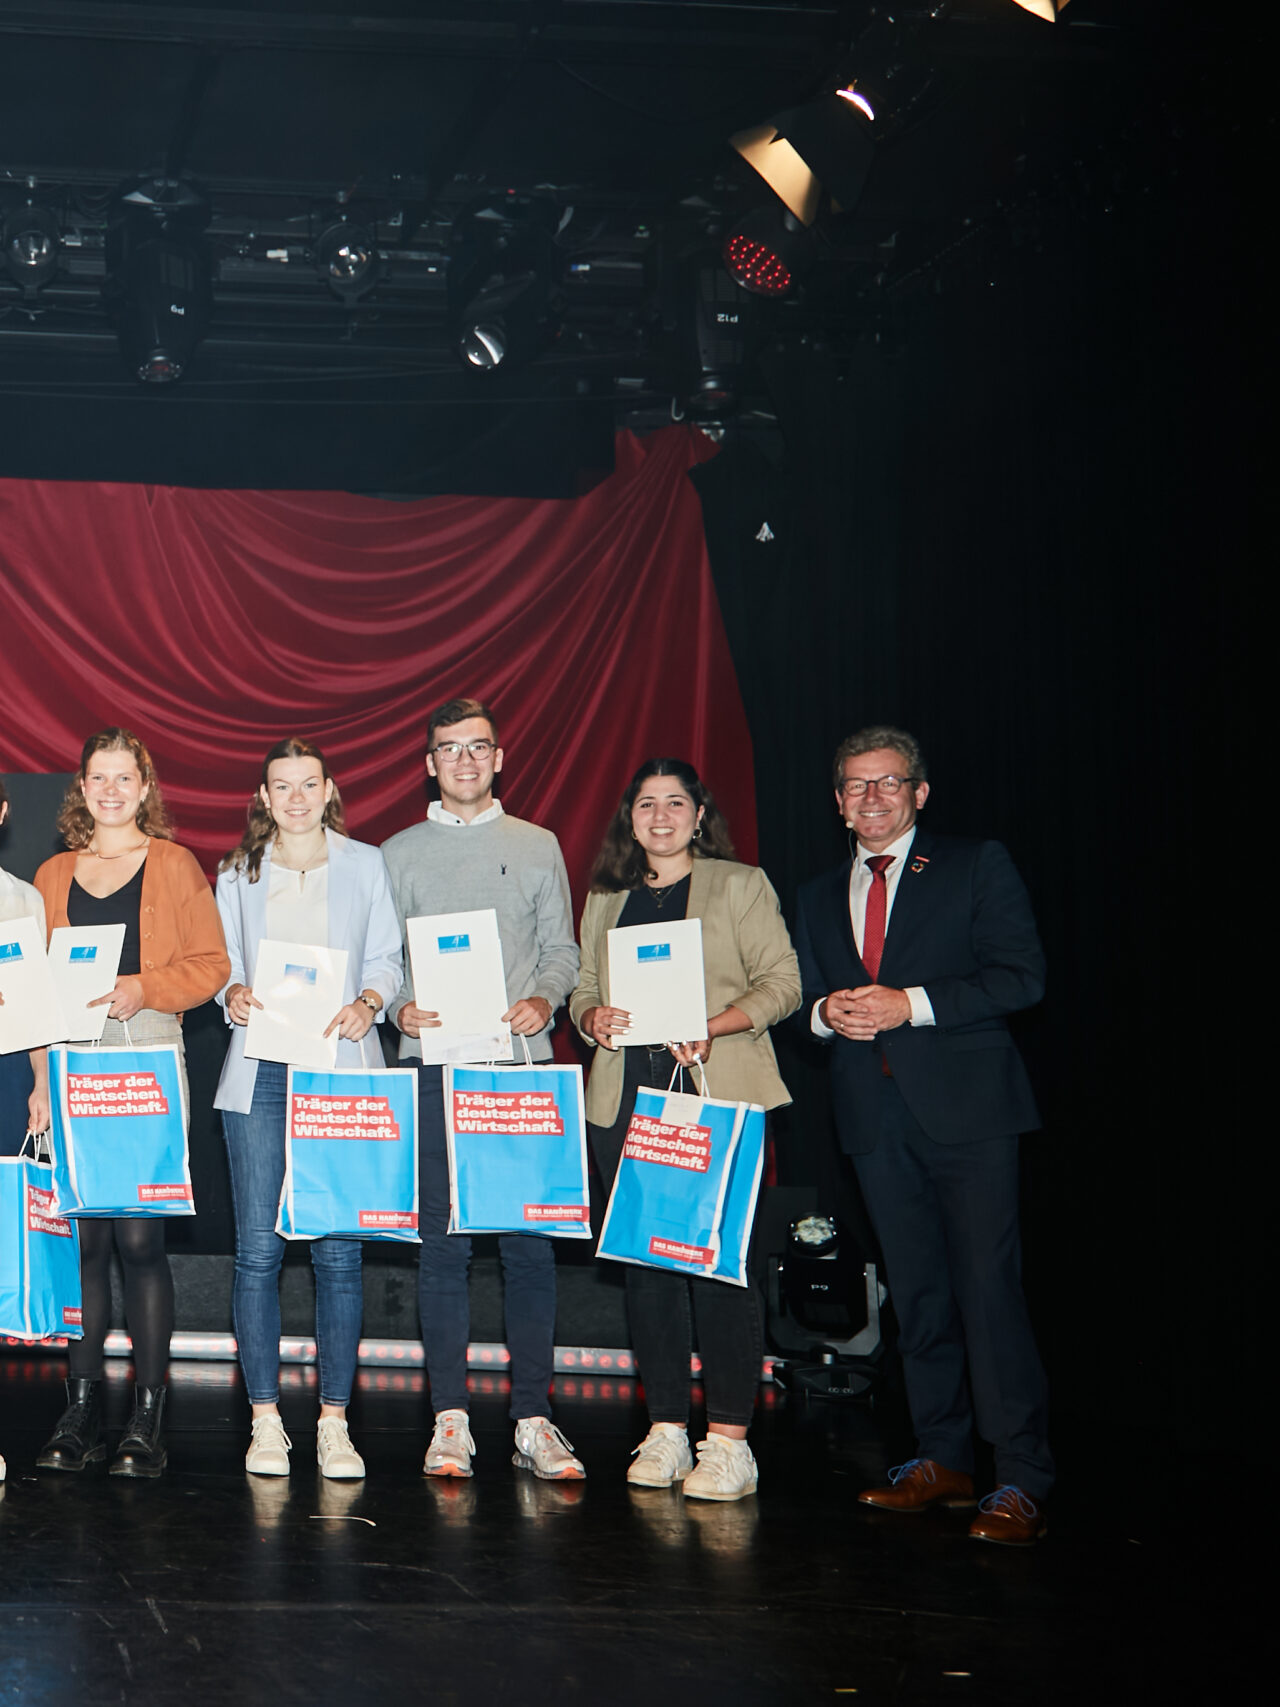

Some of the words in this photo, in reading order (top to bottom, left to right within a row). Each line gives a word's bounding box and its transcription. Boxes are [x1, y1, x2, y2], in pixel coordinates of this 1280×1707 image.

[717, 313, 739, 323] P12
[68, 1076, 121, 1091] Träger
[124, 1076, 154, 1087] der
[69, 1089, 160, 1102] deutschen
[455, 1093, 515, 1108] Träger
[519, 1095, 551, 1106] der
[70, 1101, 167, 1115] Wirtschaft.
[294, 1097, 351, 1112] Träger
[355, 1099, 386, 1111] der
[294, 1111, 391, 1124] deutschen
[457, 1107, 556, 1120] deutschen
[294, 1124, 397, 1138] Wirtschaft.
[457, 1120, 562, 1133] Wirtschaft.
[679, 1126, 708, 1141] der
[627, 1131, 707, 1156] deutschen
[626, 1144, 706, 1170] Wirtschaft.
